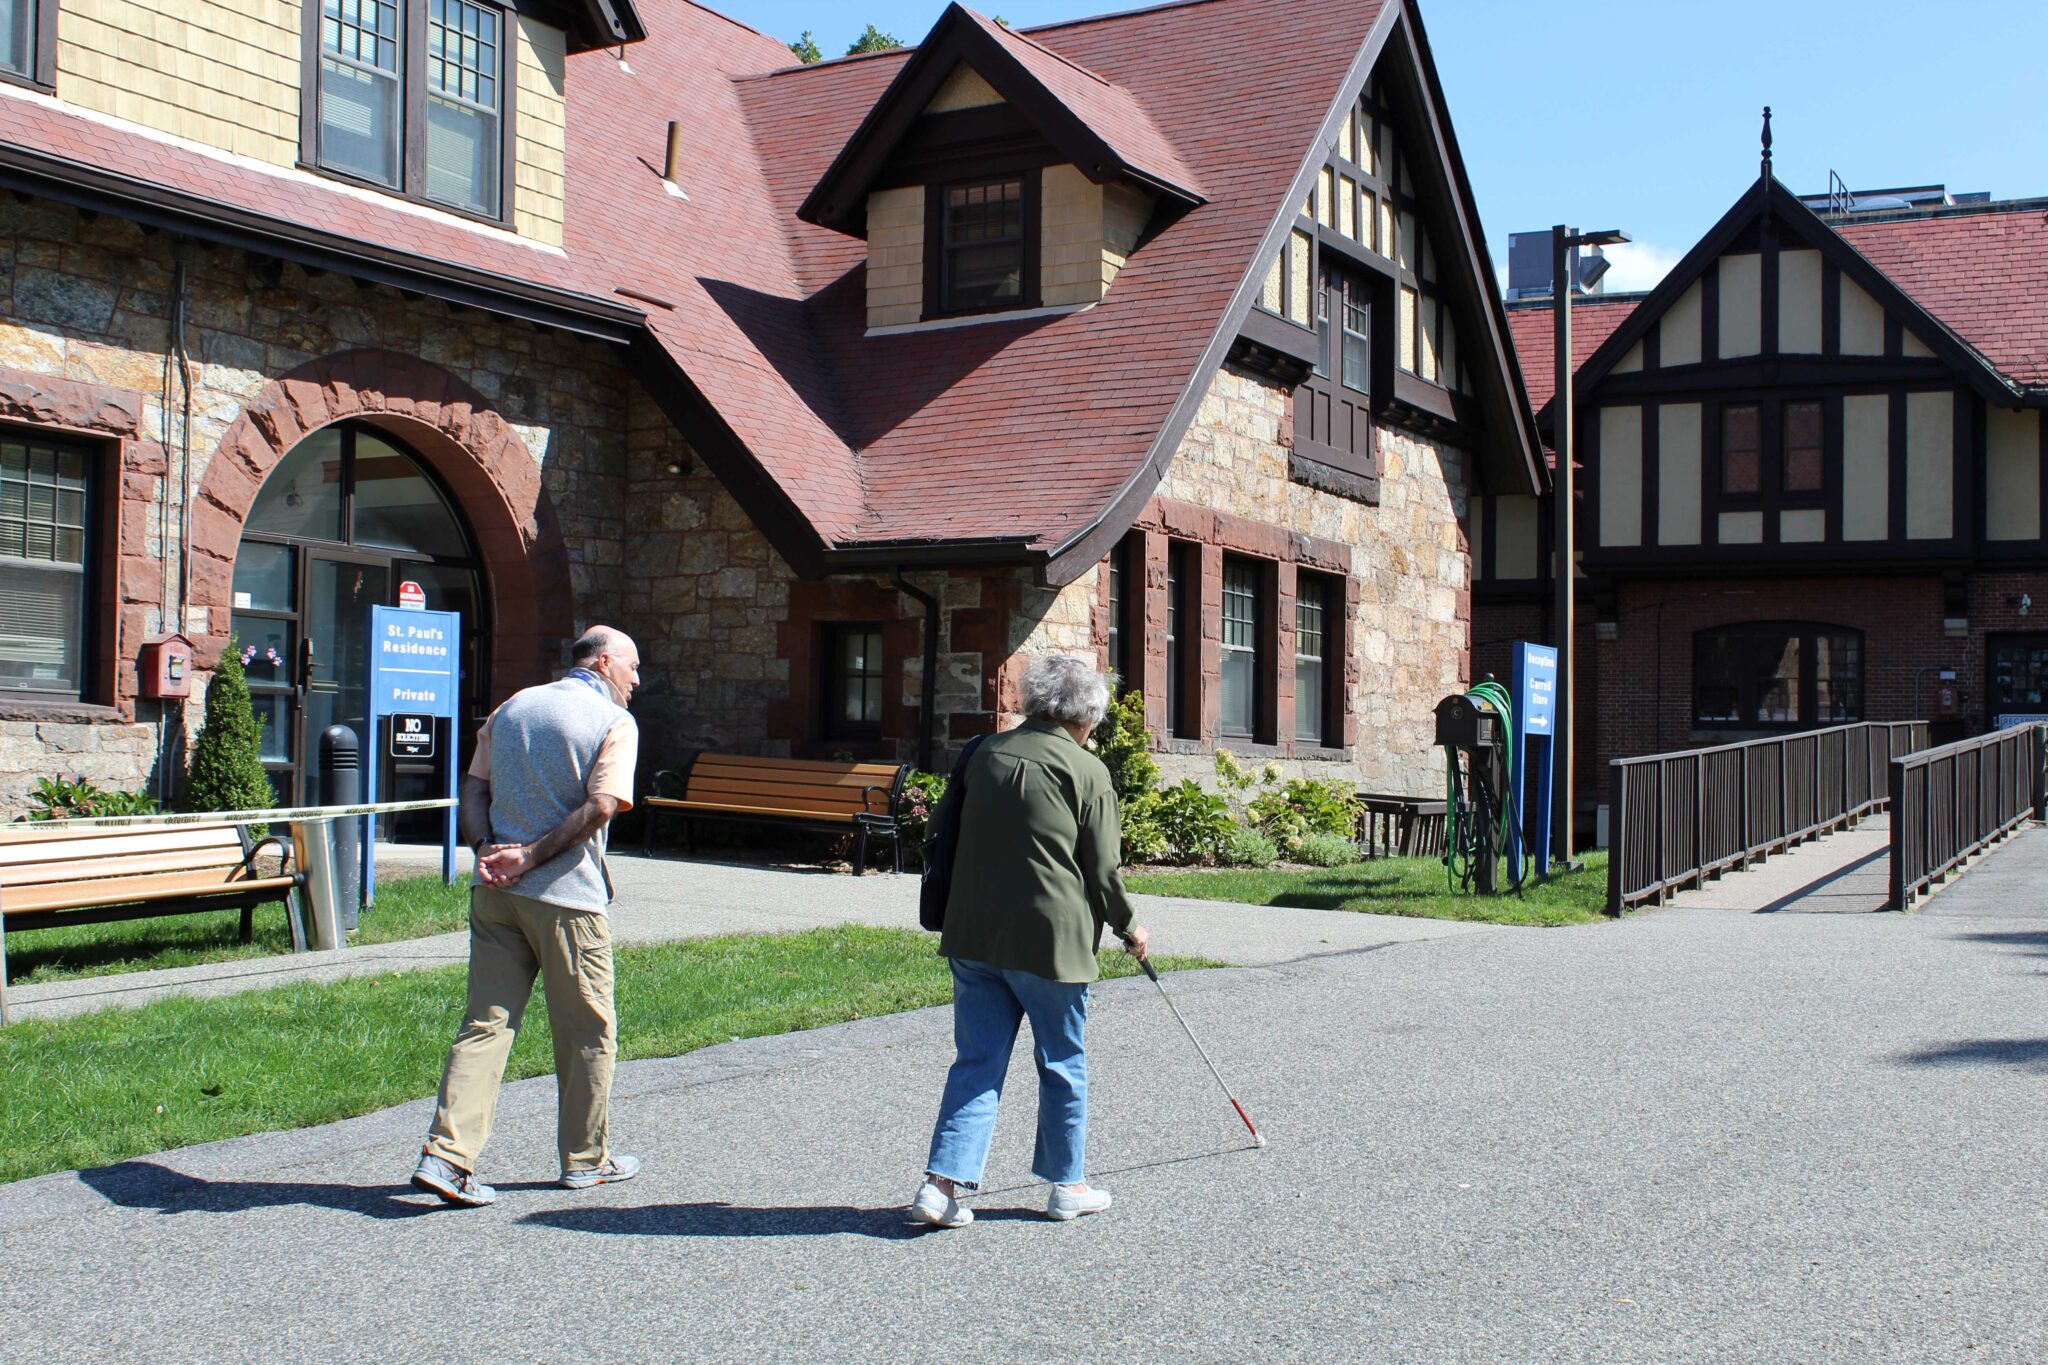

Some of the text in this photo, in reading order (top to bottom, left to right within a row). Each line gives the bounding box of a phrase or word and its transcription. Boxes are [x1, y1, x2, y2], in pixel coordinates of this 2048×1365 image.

[387, 624, 444, 640] St. Paul's
[383, 641, 447, 656] Residence
[1528, 652, 1554, 668] Reception
[1530, 677, 1552, 691] Carroll
[393, 688, 436, 701] Private
[405, 718, 421, 732] NO
